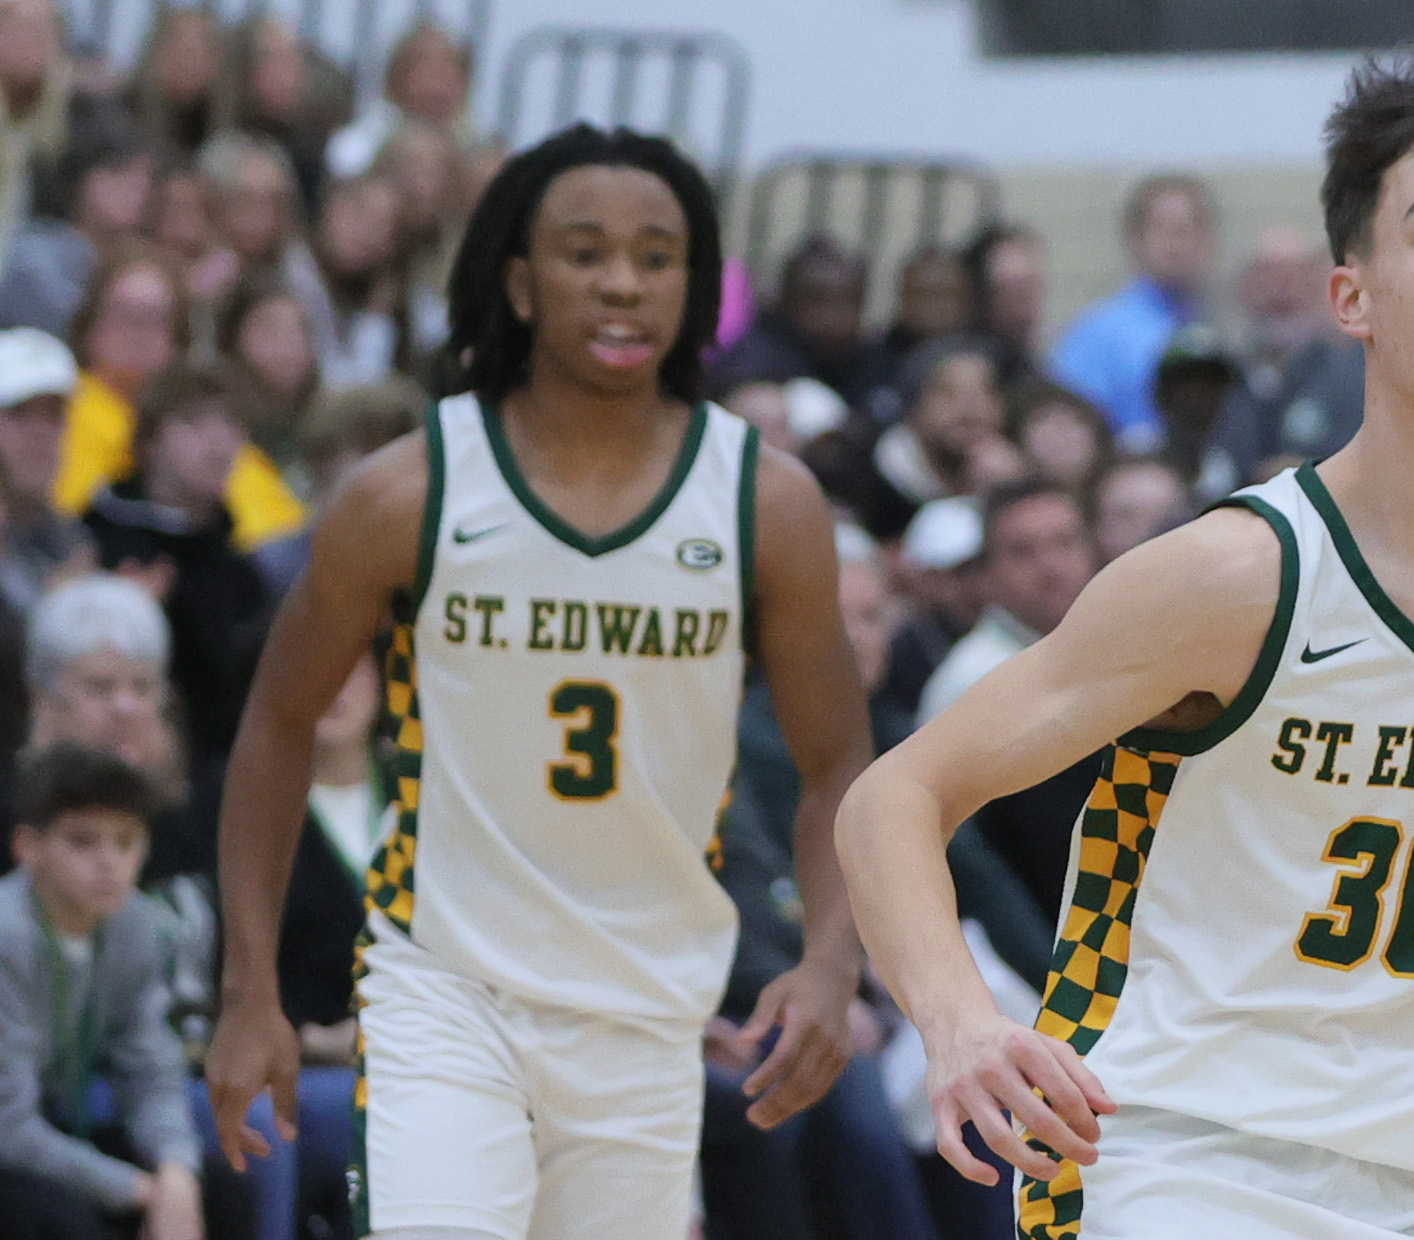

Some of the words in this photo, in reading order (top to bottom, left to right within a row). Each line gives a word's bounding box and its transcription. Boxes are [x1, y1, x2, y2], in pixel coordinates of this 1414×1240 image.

[444, 593, 508, 647] ST.
[528, 598, 729, 657] EDWARD
[547, 677, 621, 805] 3
[1271, 717, 1354, 785] ST.
